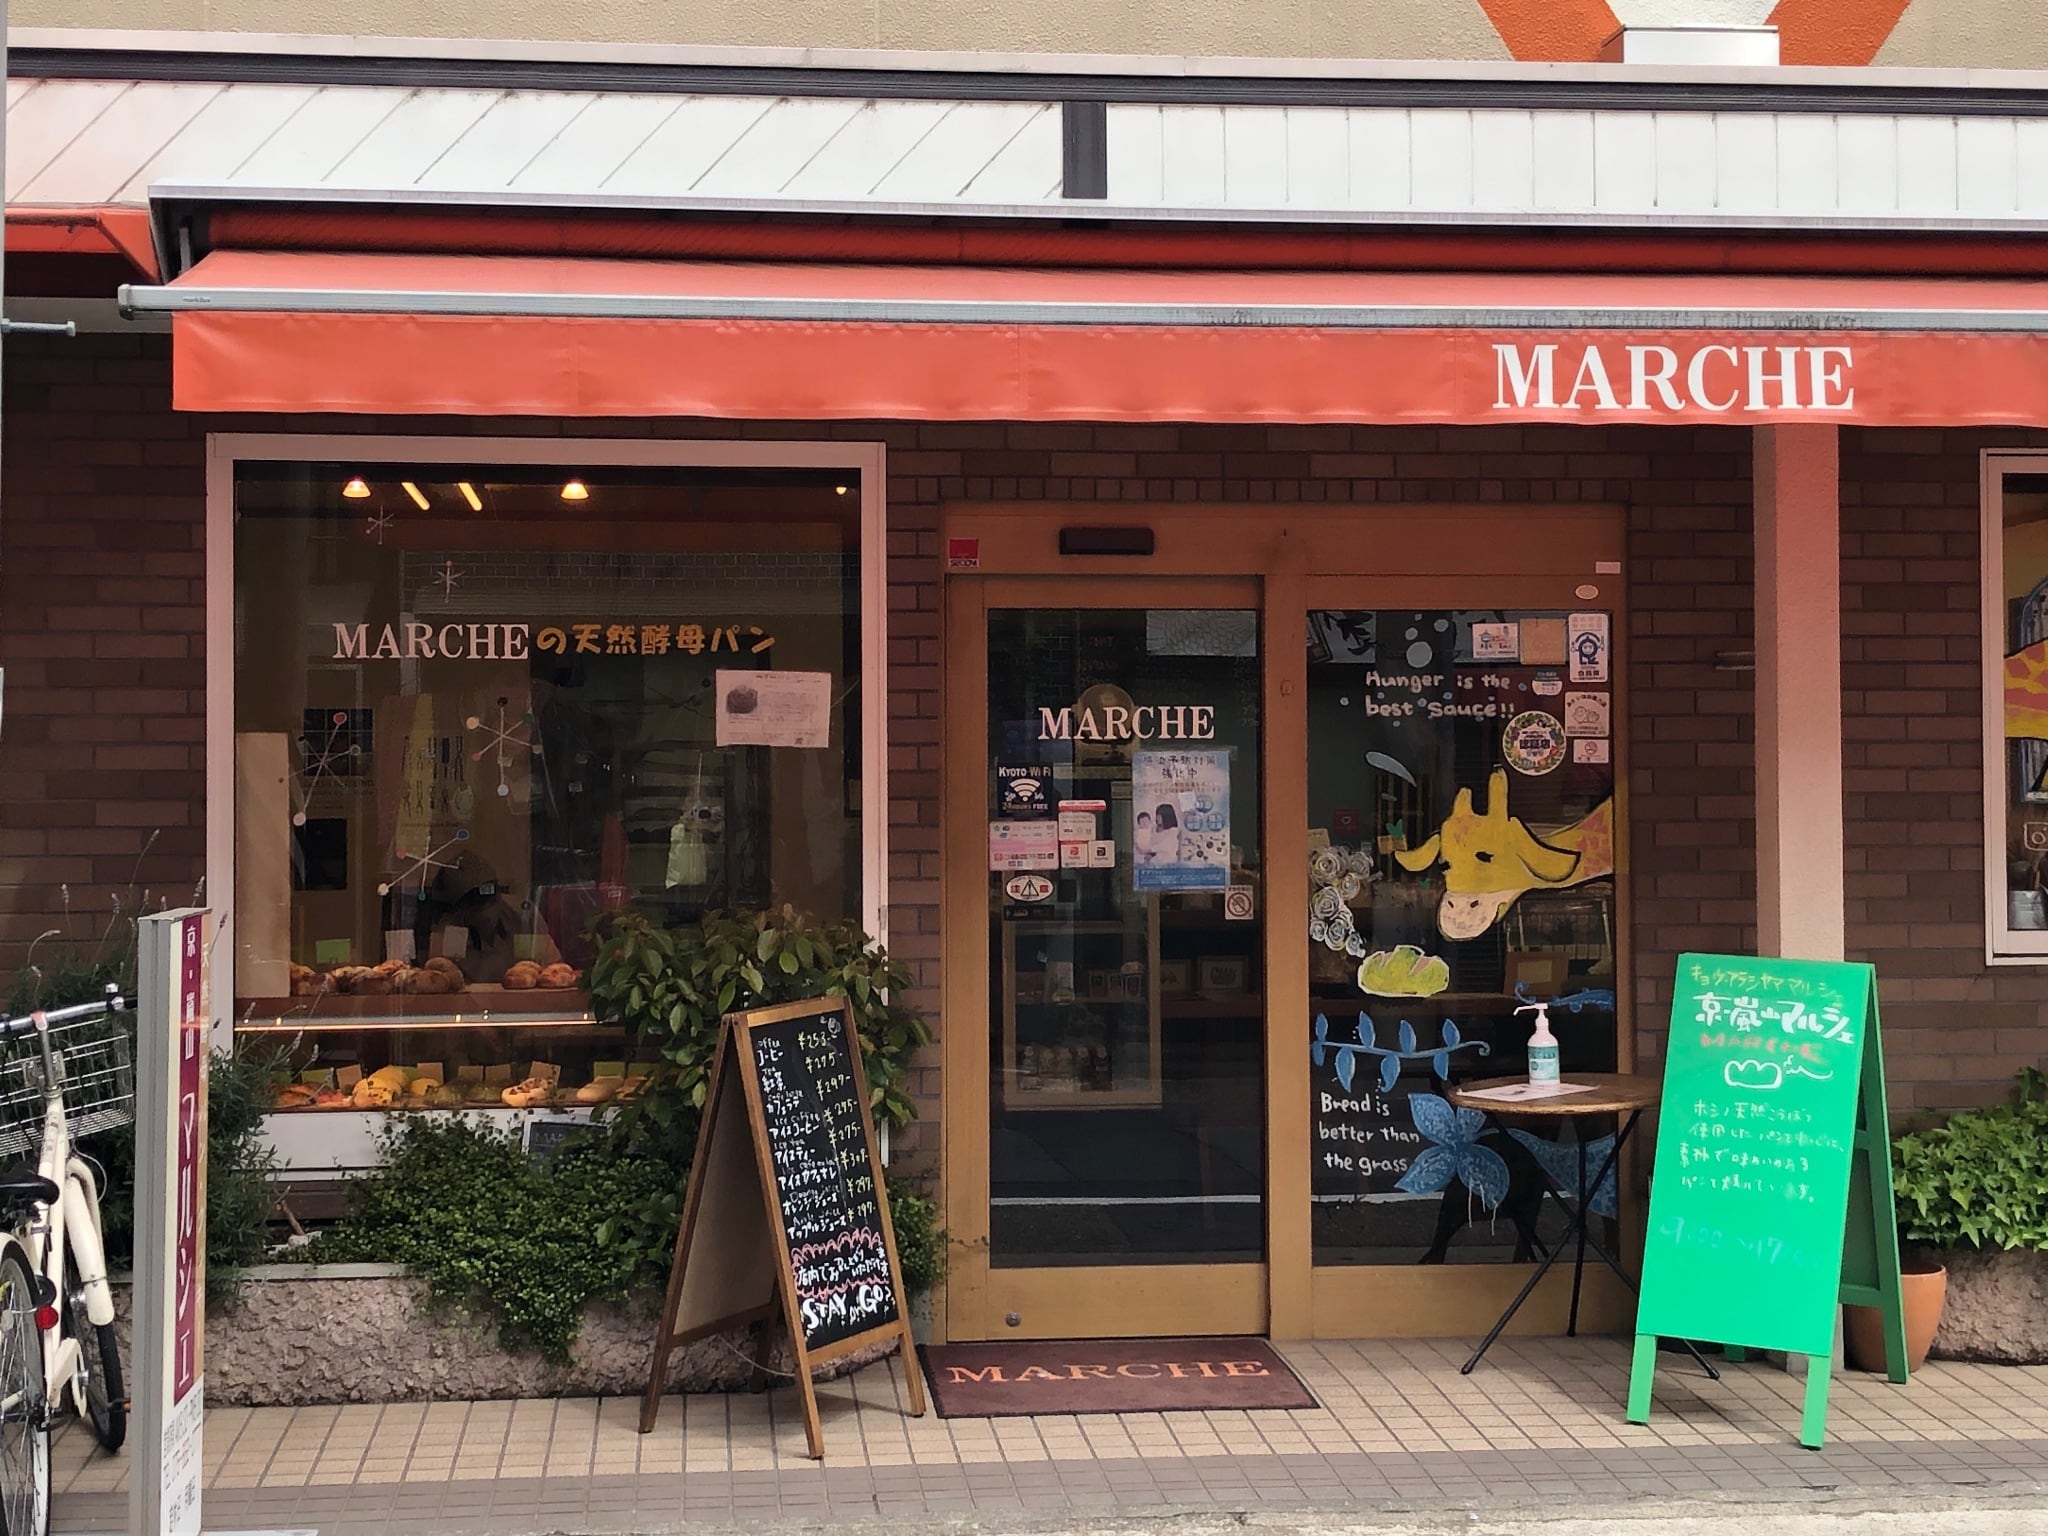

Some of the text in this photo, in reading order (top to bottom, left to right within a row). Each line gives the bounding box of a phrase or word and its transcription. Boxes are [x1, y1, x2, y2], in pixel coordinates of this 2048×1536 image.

[1491, 343, 1855, 411] MARCHE
[1365, 670, 1511, 693] Hunger is the
[1365, 694, 1413, 718] best
[1038, 705, 1216, 741] MARCHE
[1320, 1090, 1391, 1117] Bread is
[1318, 1122, 1421, 1144] better than
[1323, 1152, 1409, 1177] the grass
[802, 1292, 847, 1330] STAY
[944, 1359, 1270, 1384] MARCHE
